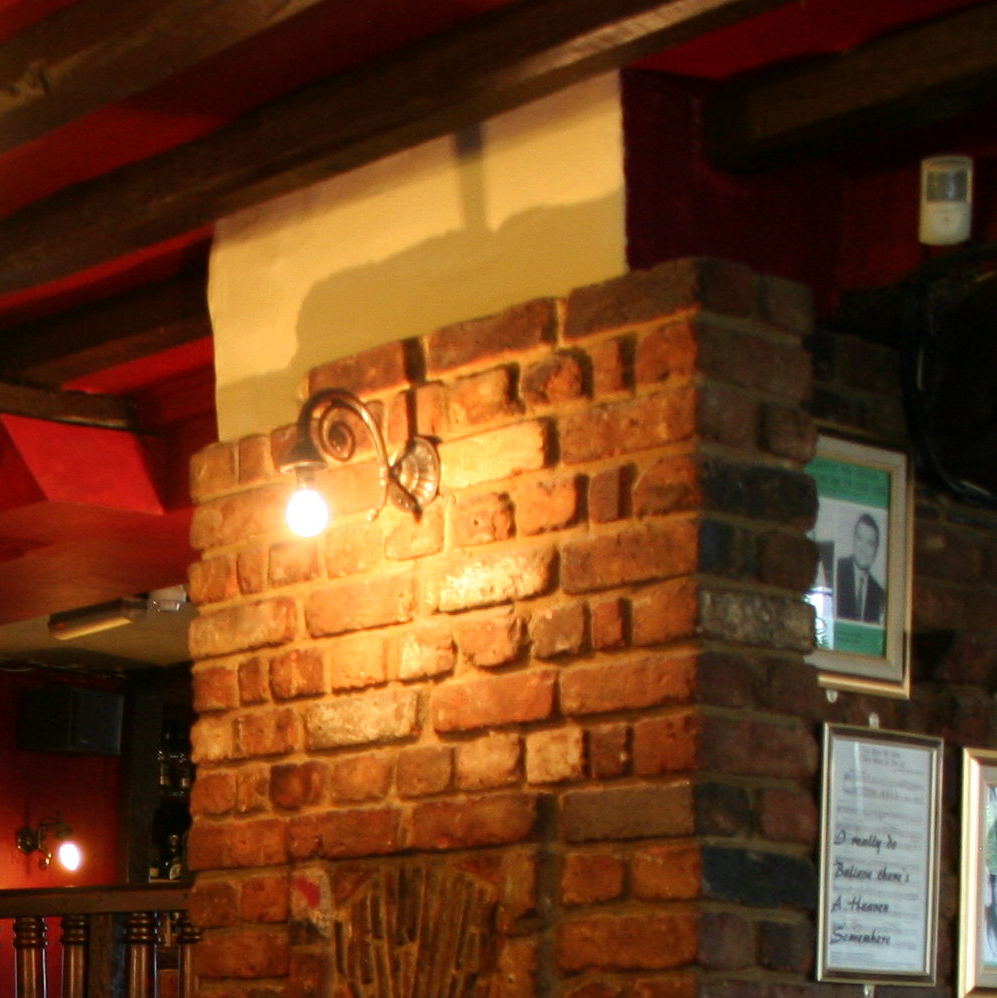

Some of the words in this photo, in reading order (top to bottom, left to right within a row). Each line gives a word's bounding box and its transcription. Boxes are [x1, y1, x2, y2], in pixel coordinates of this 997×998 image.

[851, 833, 883, 855] really
[886, 833, 898, 850] do
[834, 861, 873, 880] Believe
[831, 894, 843, 913] A
[848, 896, 891, 913] Heaven
[829, 925, 892, 946] Somewhere
